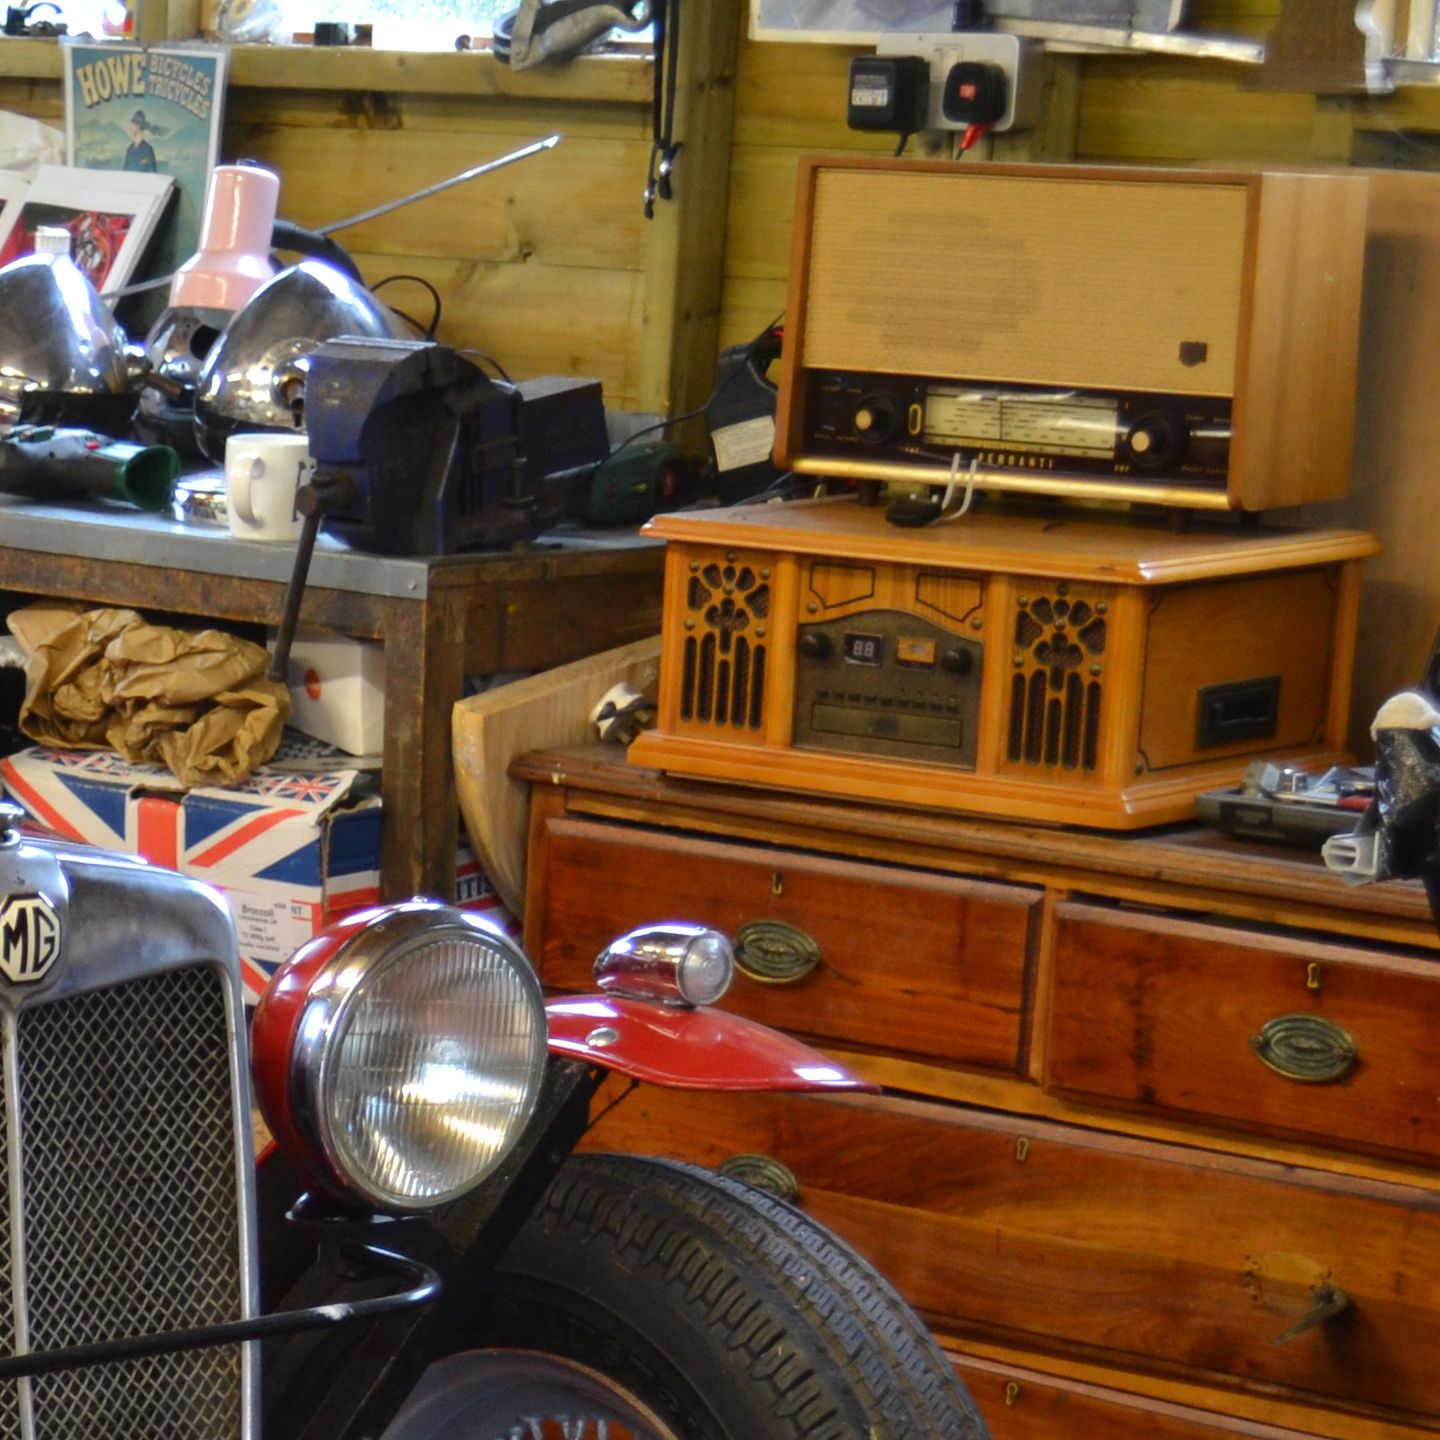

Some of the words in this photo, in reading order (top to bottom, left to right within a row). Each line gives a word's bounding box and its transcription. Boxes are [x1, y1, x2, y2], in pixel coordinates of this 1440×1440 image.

[76, 53, 147, 109] HOWE
[148, 74, 211, 120] TRICYCLES
[150, 53, 212, 96] BICYCLES
[978, 451, 1054, 470] FERRANTI
[1, 904, 57, 975] MG
